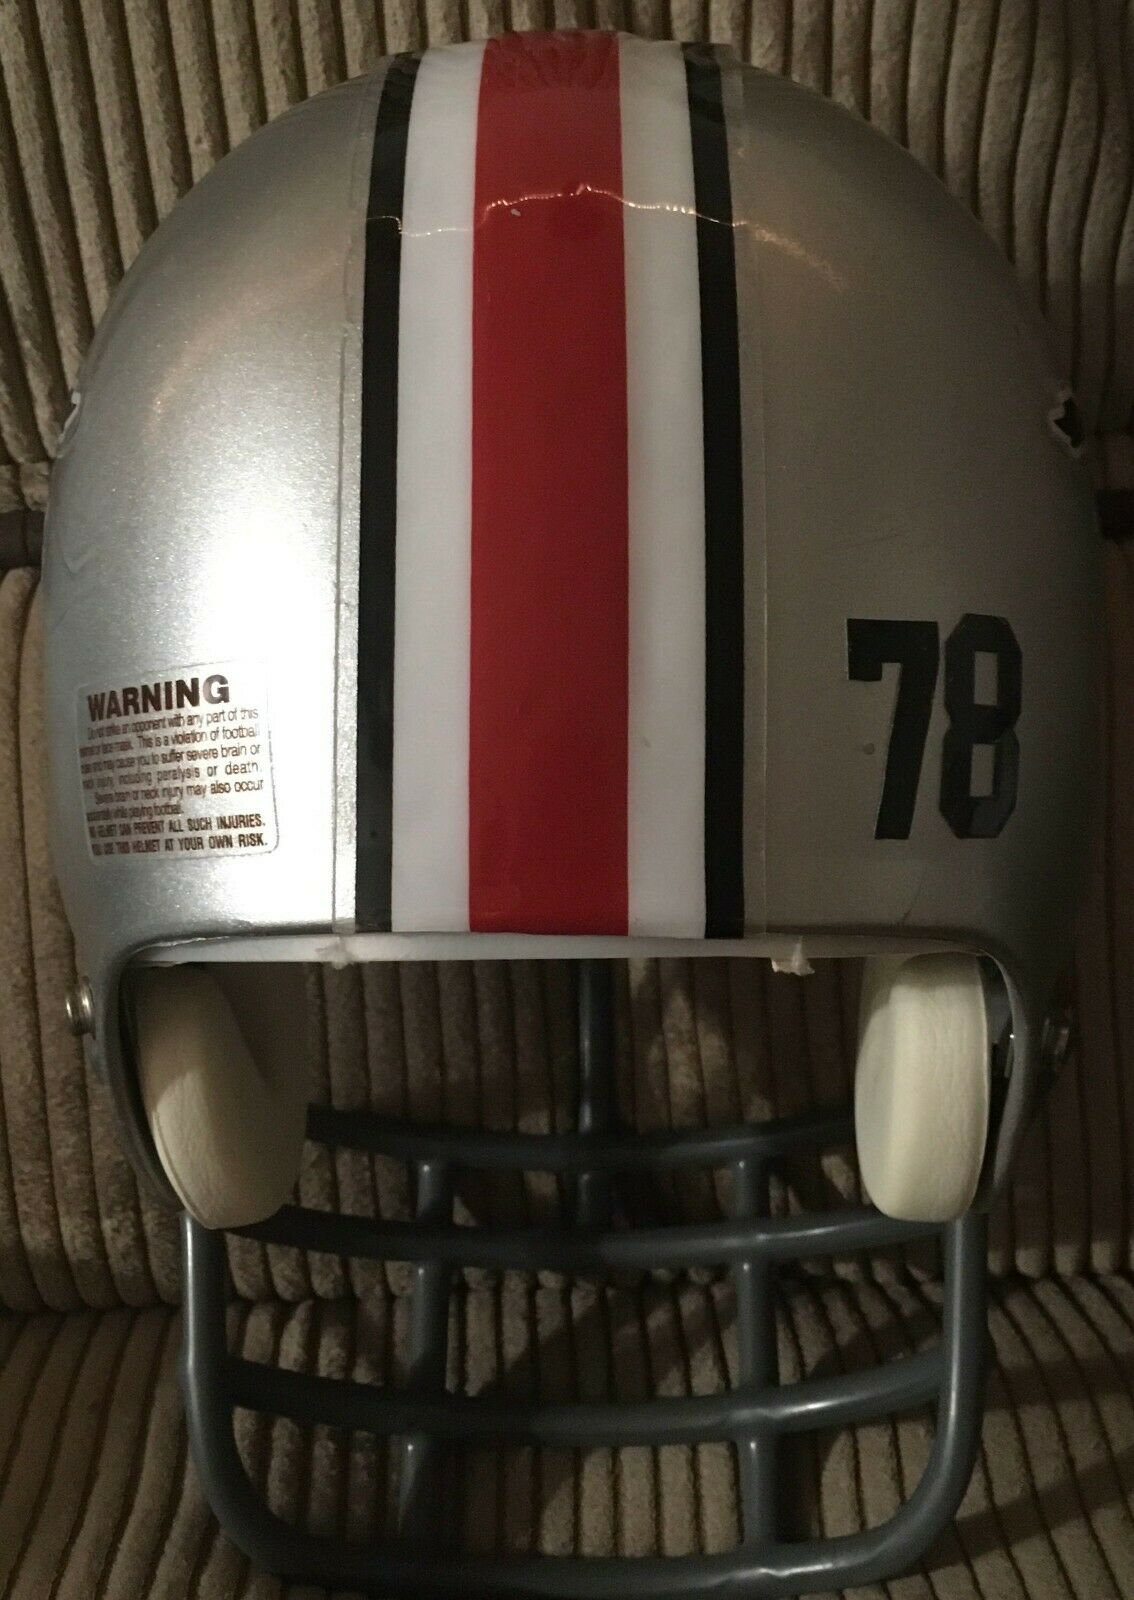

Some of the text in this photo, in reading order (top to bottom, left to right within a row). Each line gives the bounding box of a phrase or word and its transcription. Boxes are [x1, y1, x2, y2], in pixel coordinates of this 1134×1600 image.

[87, 675, 230, 720] WARNING
[187, 714, 203, 728] any
[206, 710, 225, 724] part
[228, 709, 237, 721] of
[240, 707, 259, 719] this
[847, 613, 1023, 840] 78
[210, 729, 220, 741] of
[187, 748, 218, 761] severe
[221, 743, 247, 758] brain
[250, 744, 261, 755] or
[157, 766, 200, 783] paralysis
[207, 765, 218, 777] or
[187, 784, 207, 798] may
[211, 781, 231, 794] also
[234, 779, 264, 792] occur
[168, 819, 183, 833] ALL
[187, 817, 212, 832] SUCH
[217, 814, 266, 828] INJURIES.
[165, 838, 175, 852] AT
[178, 836, 204, 851] YOUR
[209, 835, 233, 848] OWN
[238, 833, 268, 848] RISK.
